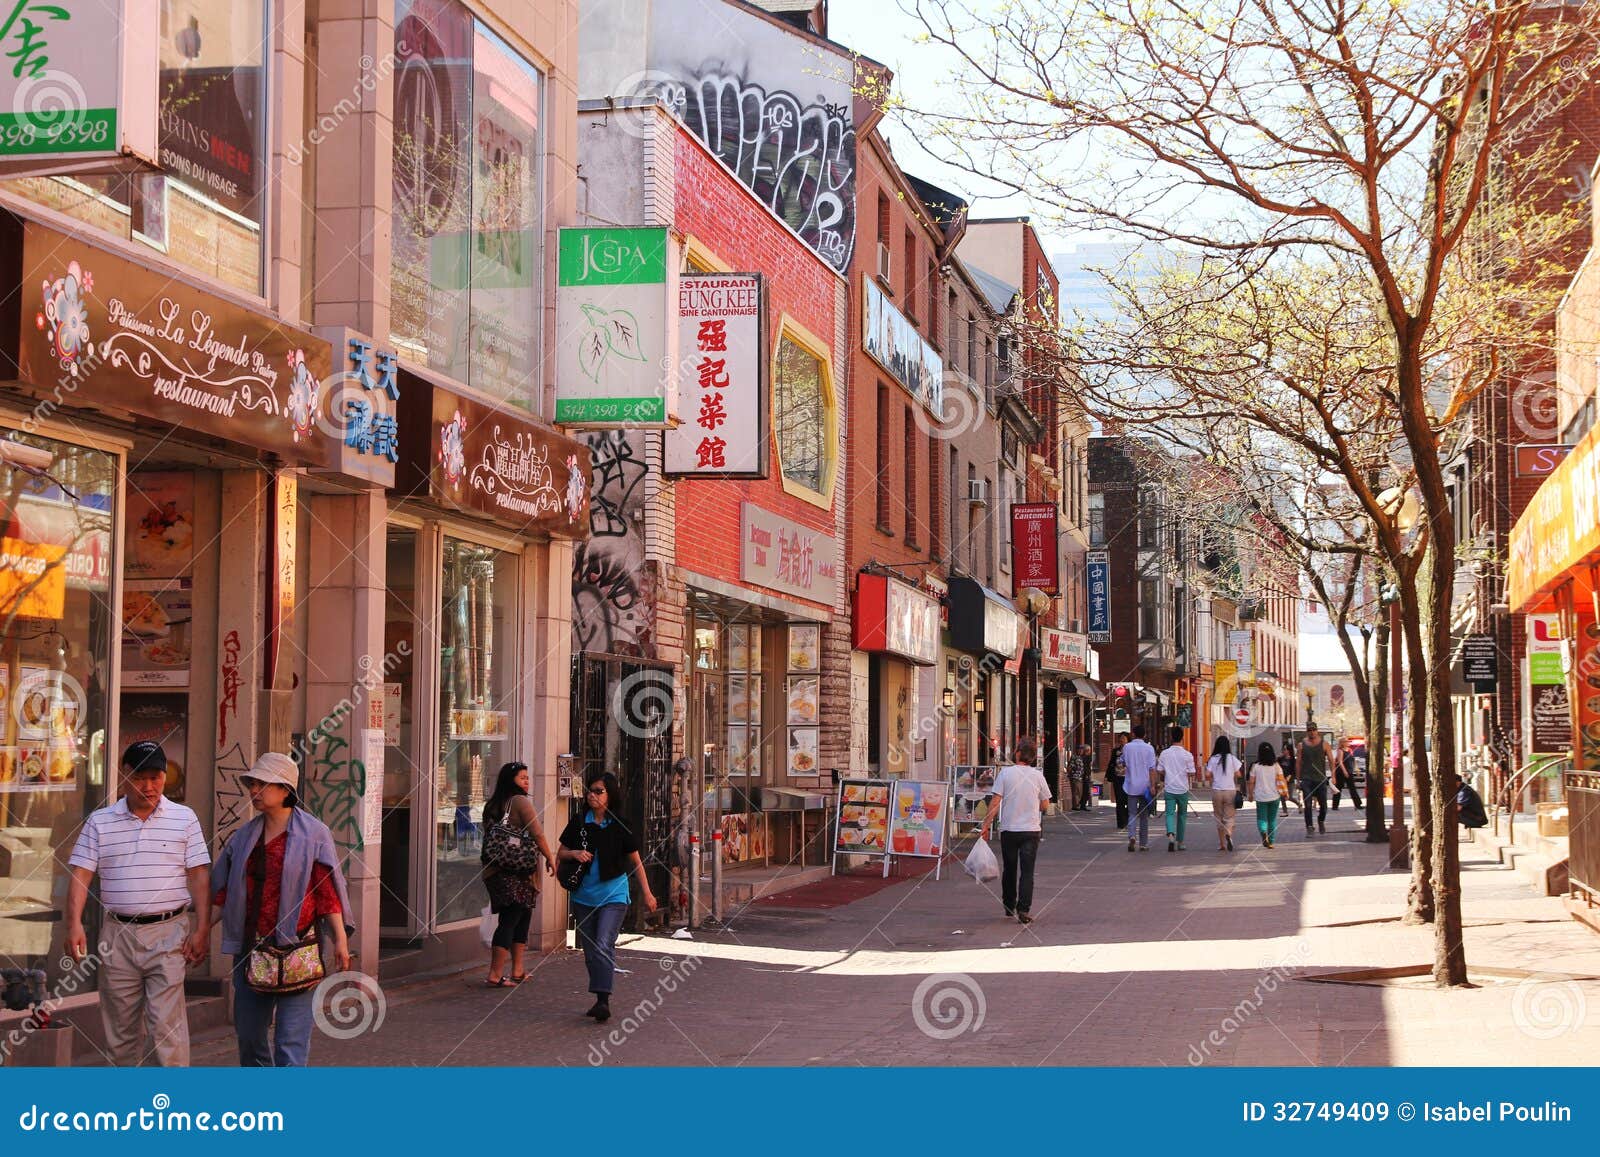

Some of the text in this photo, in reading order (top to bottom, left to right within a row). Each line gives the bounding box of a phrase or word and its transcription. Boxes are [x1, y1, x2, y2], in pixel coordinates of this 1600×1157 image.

[48, 120, 109, 145] 9398
[163, 148, 191, 176] SOINS
[192, 163, 205, 182] DU
[206, 169, 239, 199] VISAGE
[210, 134, 250, 175] MEN
[701, 307, 758, 317] CANTONNAISE
[727, 288, 757, 308] KEE
[108, 297, 279, 388] Pâtisserie La Légende Pastry
[350, 338, 400, 400] 天天
[153, 367, 238, 418] restaurant
[496, 489, 540, 518] restaurant
[1014, 512, 1054, 520] Cantonais
[1027, 520, 1043, 577] 廣州酒家
